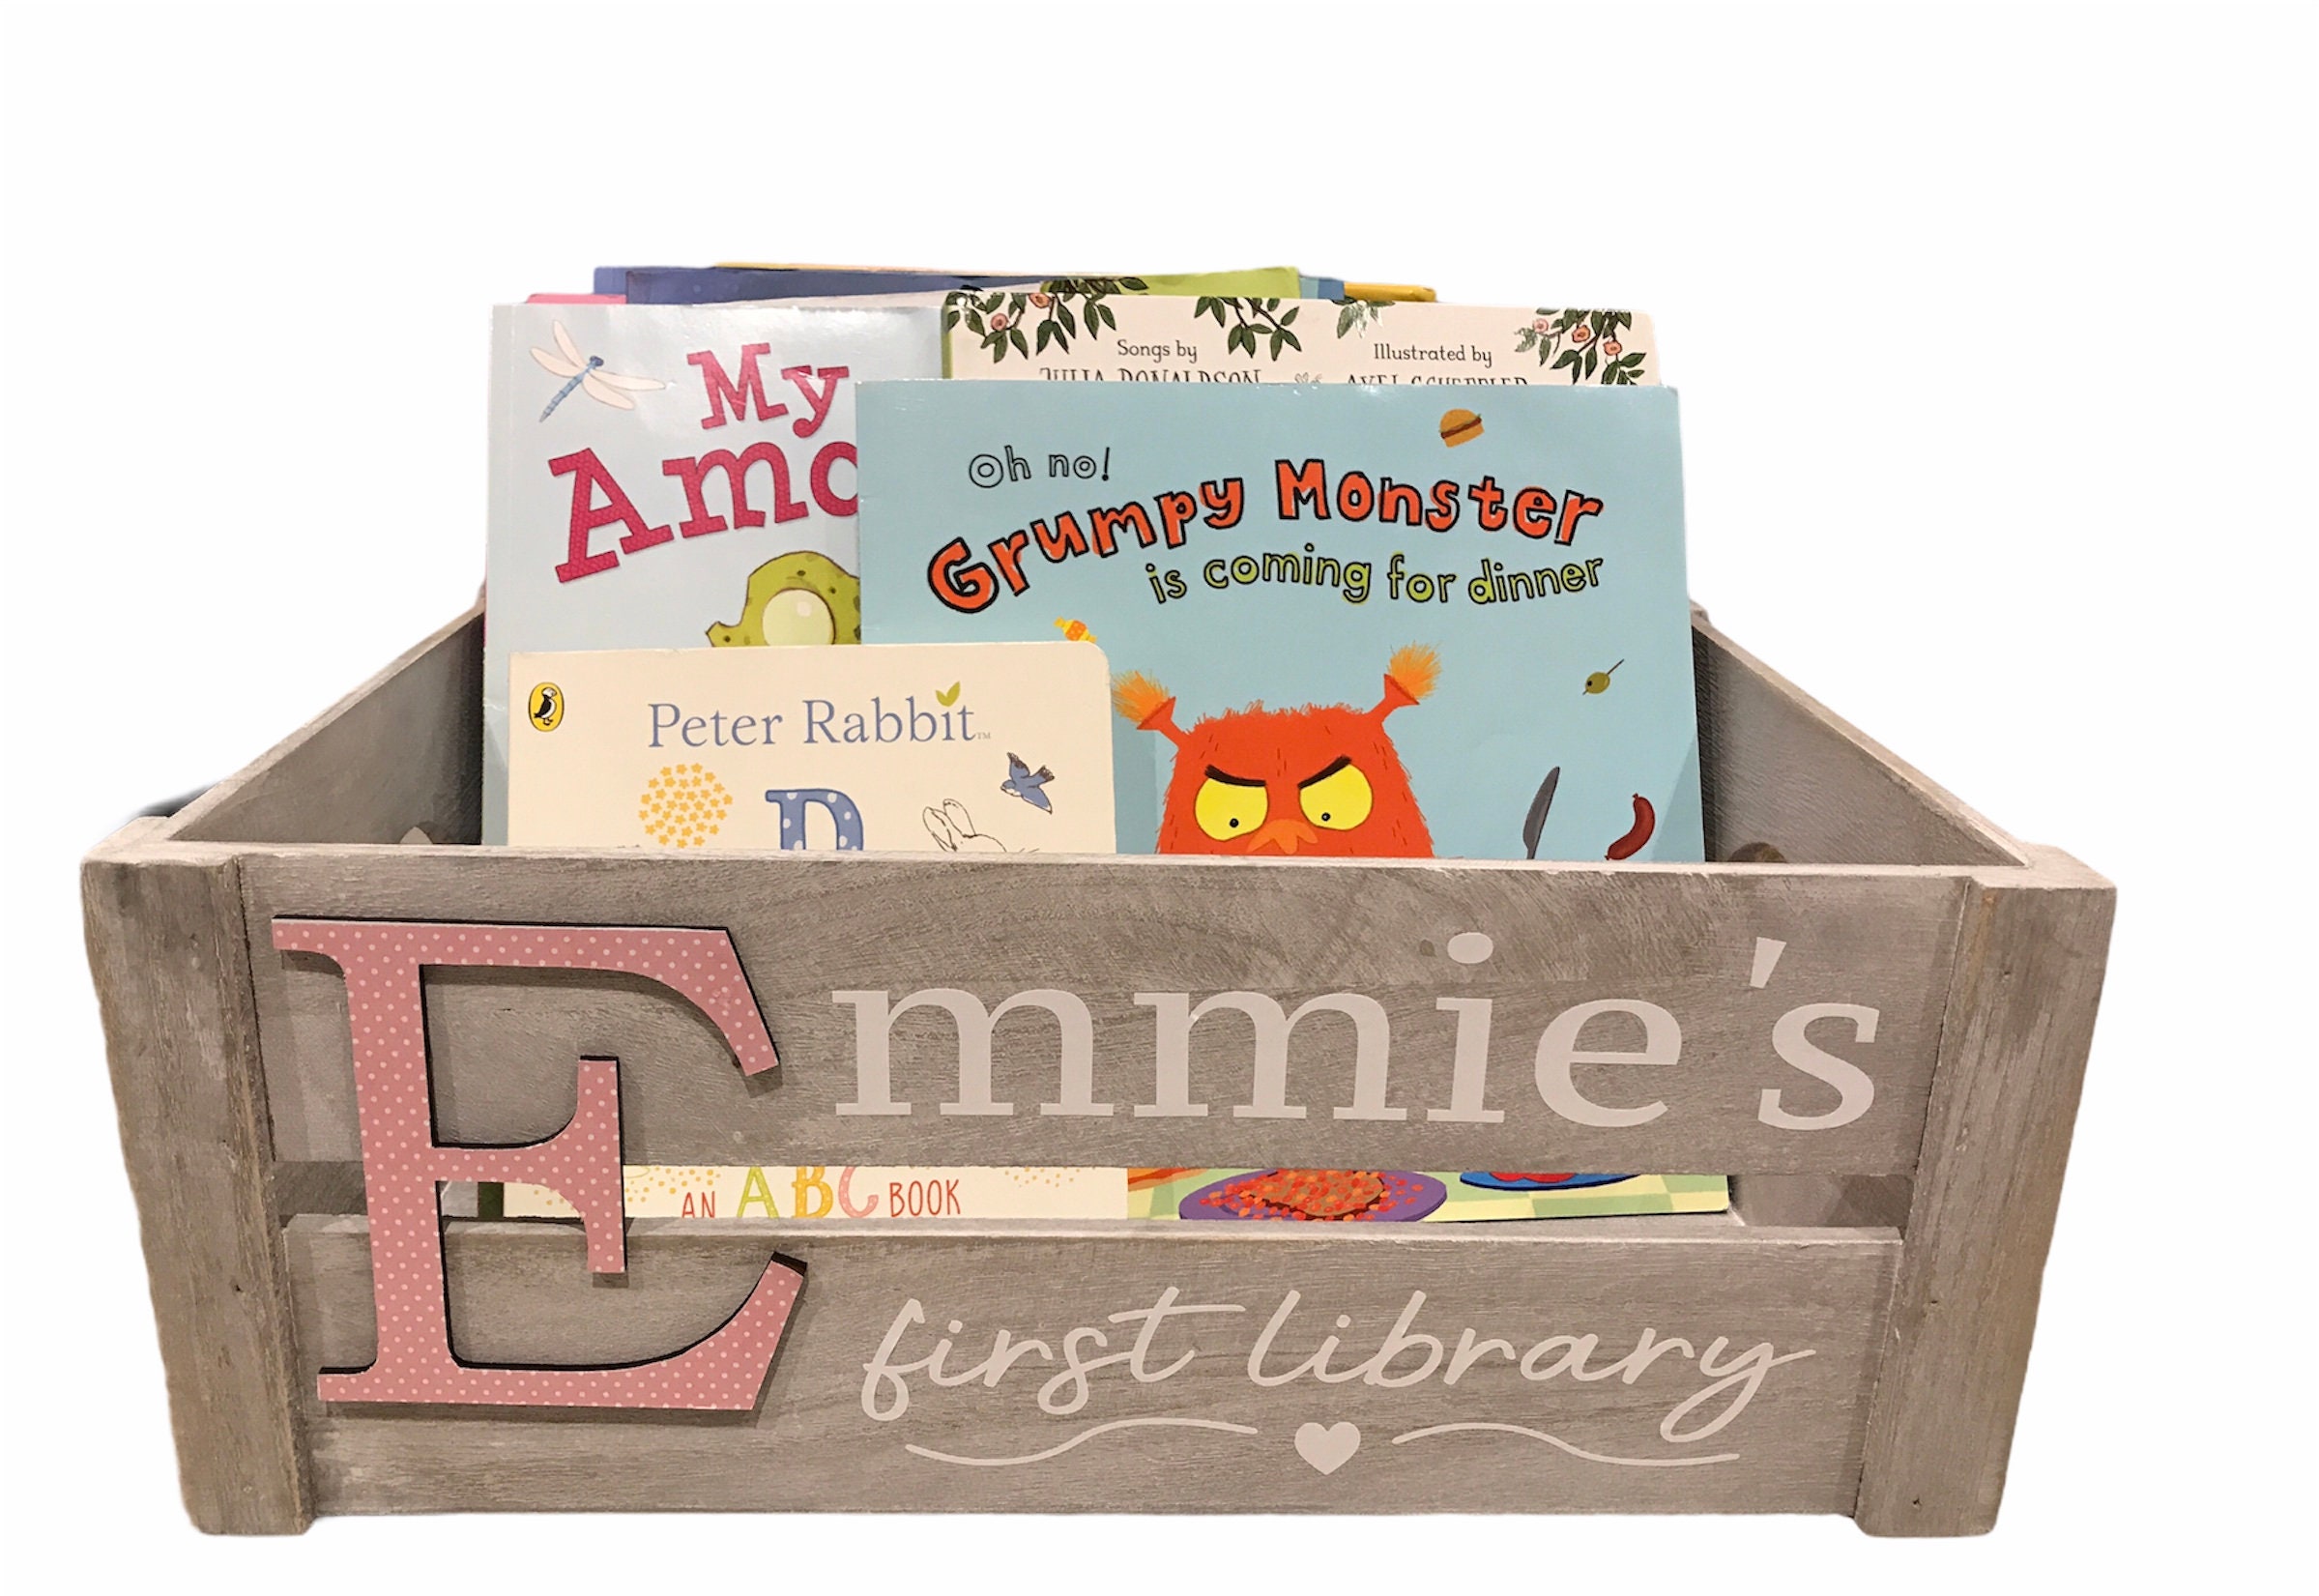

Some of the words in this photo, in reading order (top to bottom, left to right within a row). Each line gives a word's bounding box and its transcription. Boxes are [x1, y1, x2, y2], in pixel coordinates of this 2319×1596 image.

[1116, 338, 1171, 363] Songs
[1176, 340, 1198, 363] by
[1373, 342, 1465, 362] Illustrated
[1471, 345, 1493, 368] by
[686, 342, 850, 439] My
[1049, 447, 1111, 481] no!
[928, 477, 1245, 614] Grumpy
[1274, 459, 1604, 545] Monster
[1145, 563, 1188, 605] is
[1203, 543, 1372, 604] coming
[1388, 551, 1457, 603] for
[1468, 558, 1604, 604] dinner
[648, 703, 783, 747] Peter
[802, 681, 976, 744] Rabbit
[681, 1191, 716, 1218] AN
[888, 1178, 962, 1218] BOOK
[860, 1286, 1246, 1422] first
[1247, 1289, 1816, 1443] library
